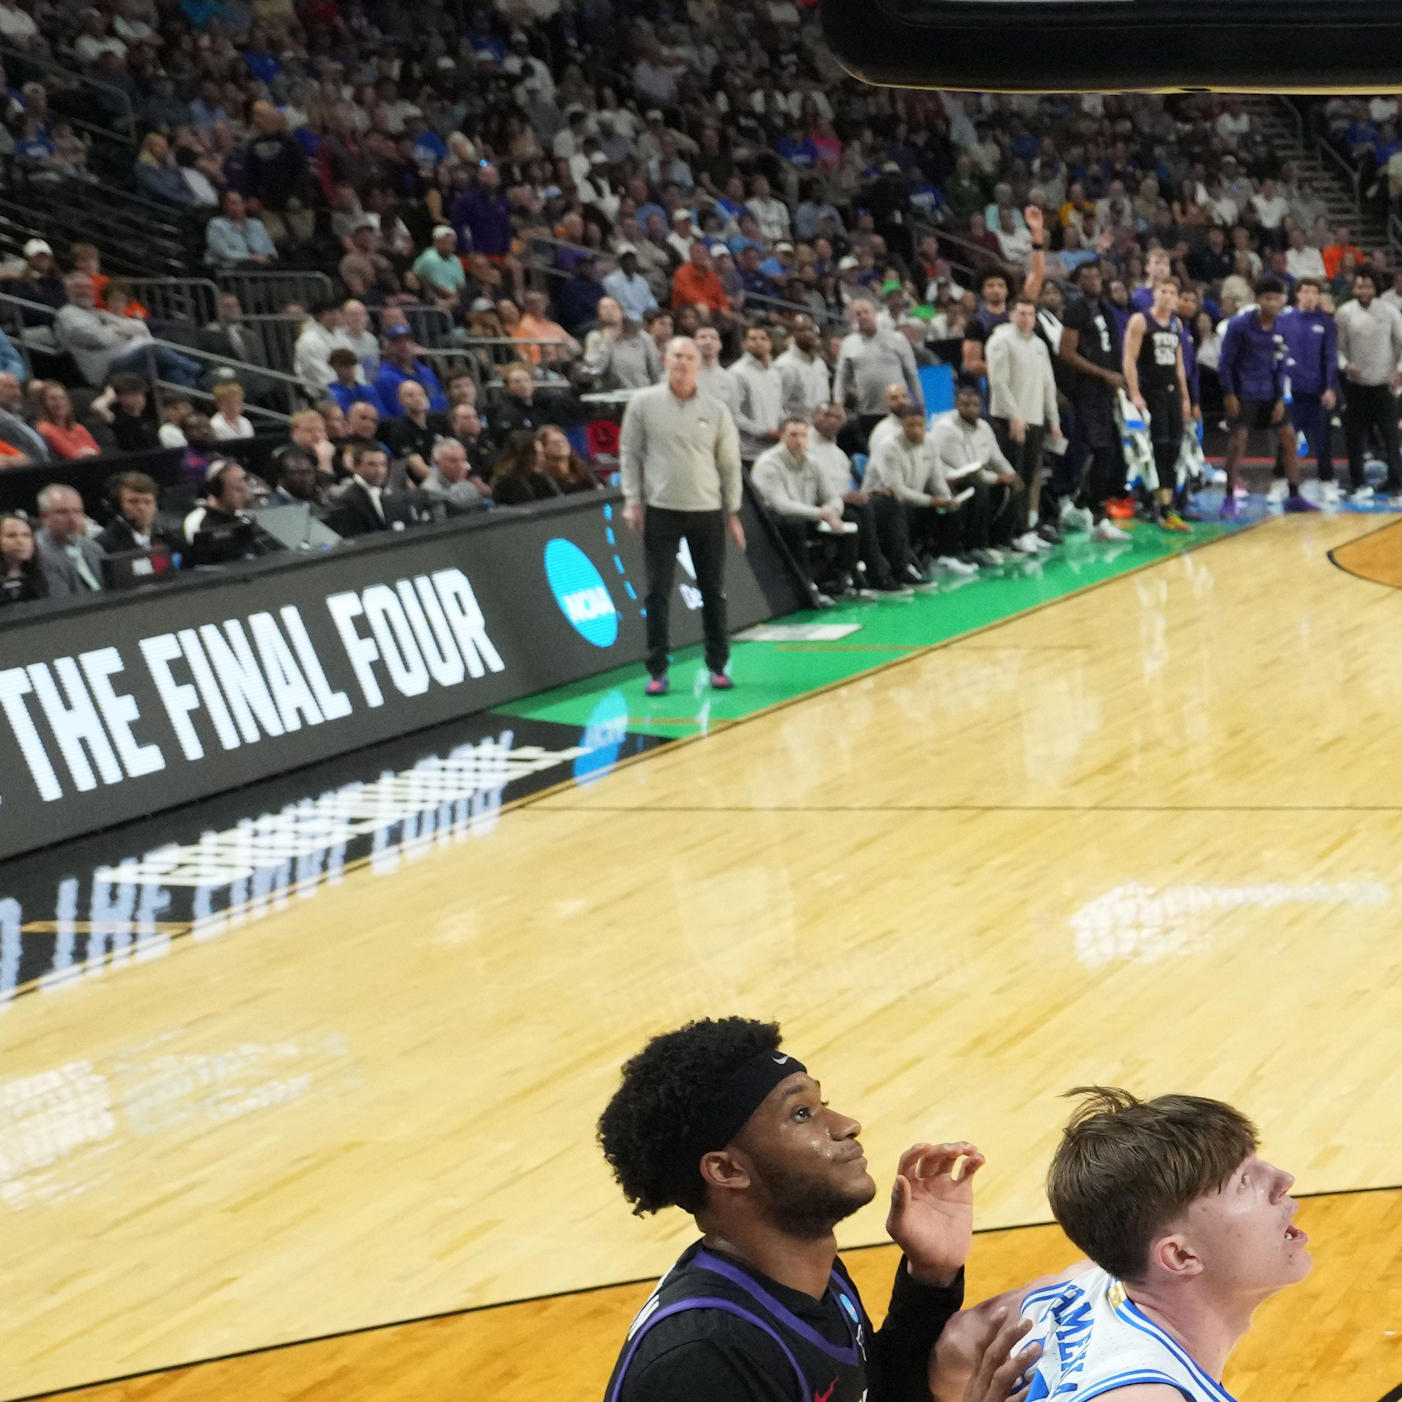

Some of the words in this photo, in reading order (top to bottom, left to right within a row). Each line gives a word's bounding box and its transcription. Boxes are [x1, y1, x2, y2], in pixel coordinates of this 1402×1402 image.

[0, 646, 166, 802] THE
[139, 605, 353, 762] FINAL
[326, 567, 504, 708] FOUR
